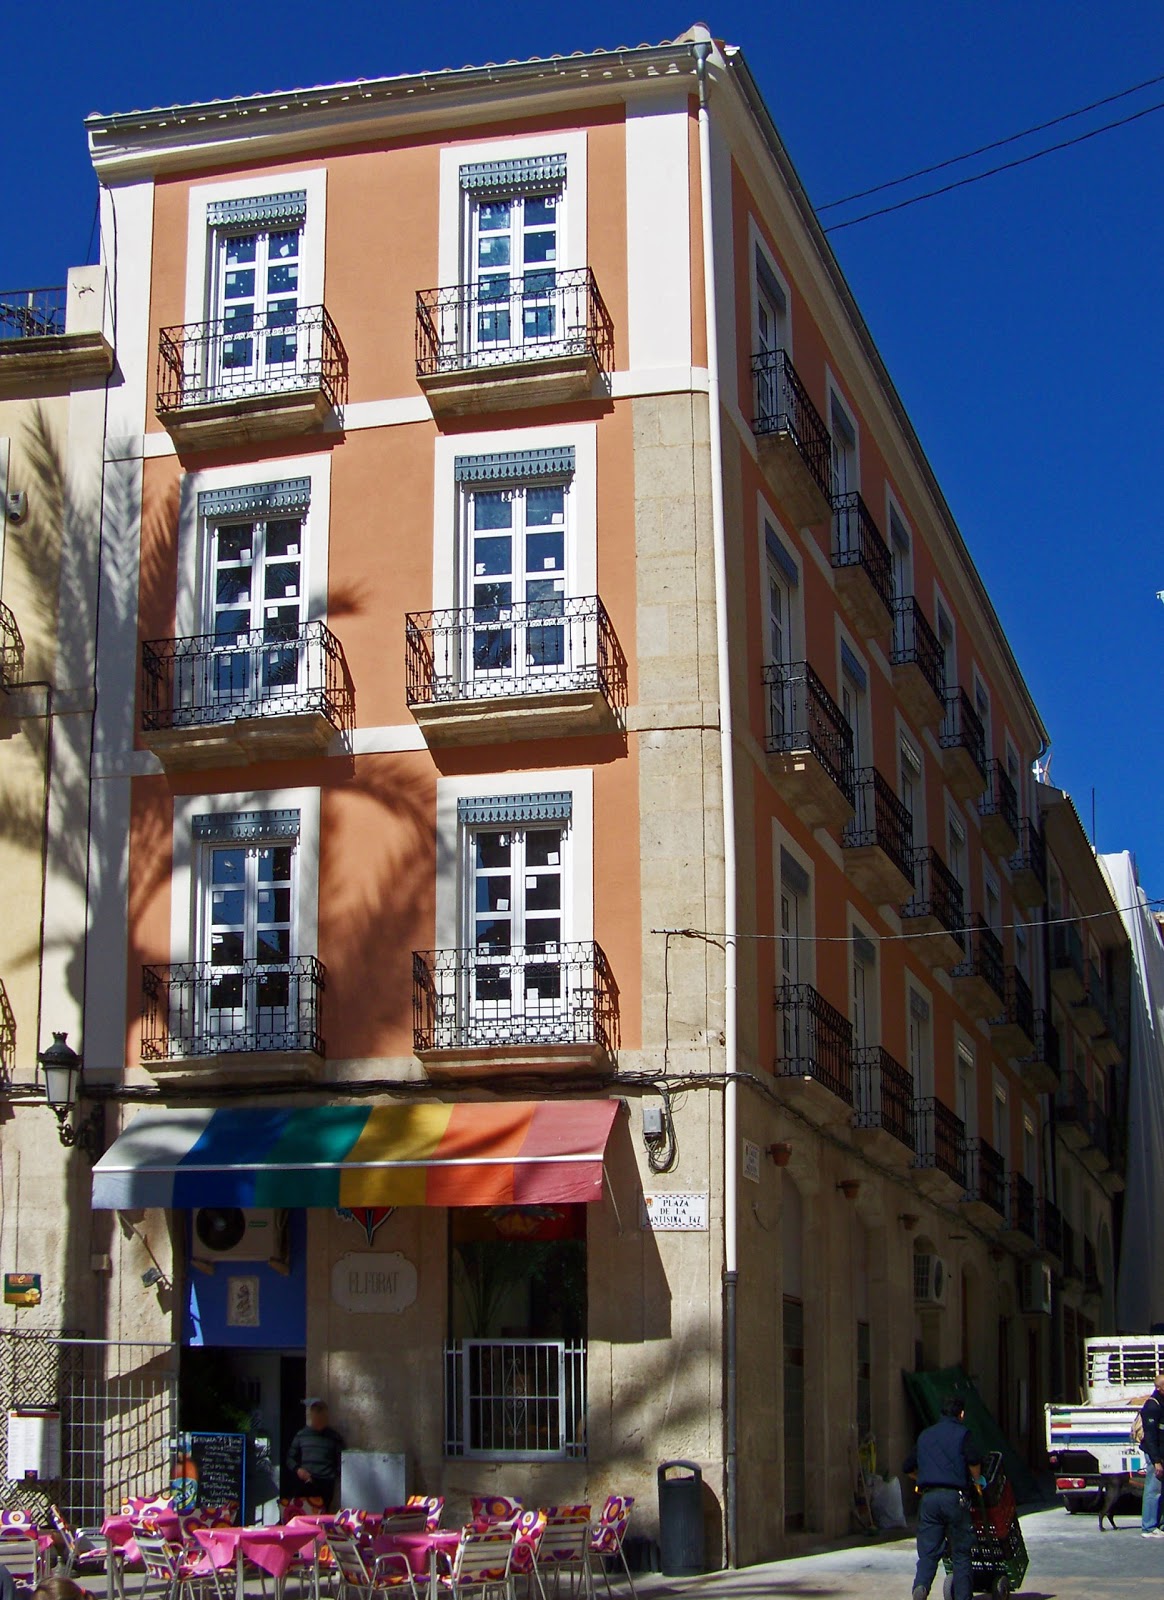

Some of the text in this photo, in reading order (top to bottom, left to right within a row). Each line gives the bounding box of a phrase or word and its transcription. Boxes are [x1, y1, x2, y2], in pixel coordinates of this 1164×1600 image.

[663, 1199, 689, 1207] PLAZA
[347, 1271, 400, 1295] EL FORAT
